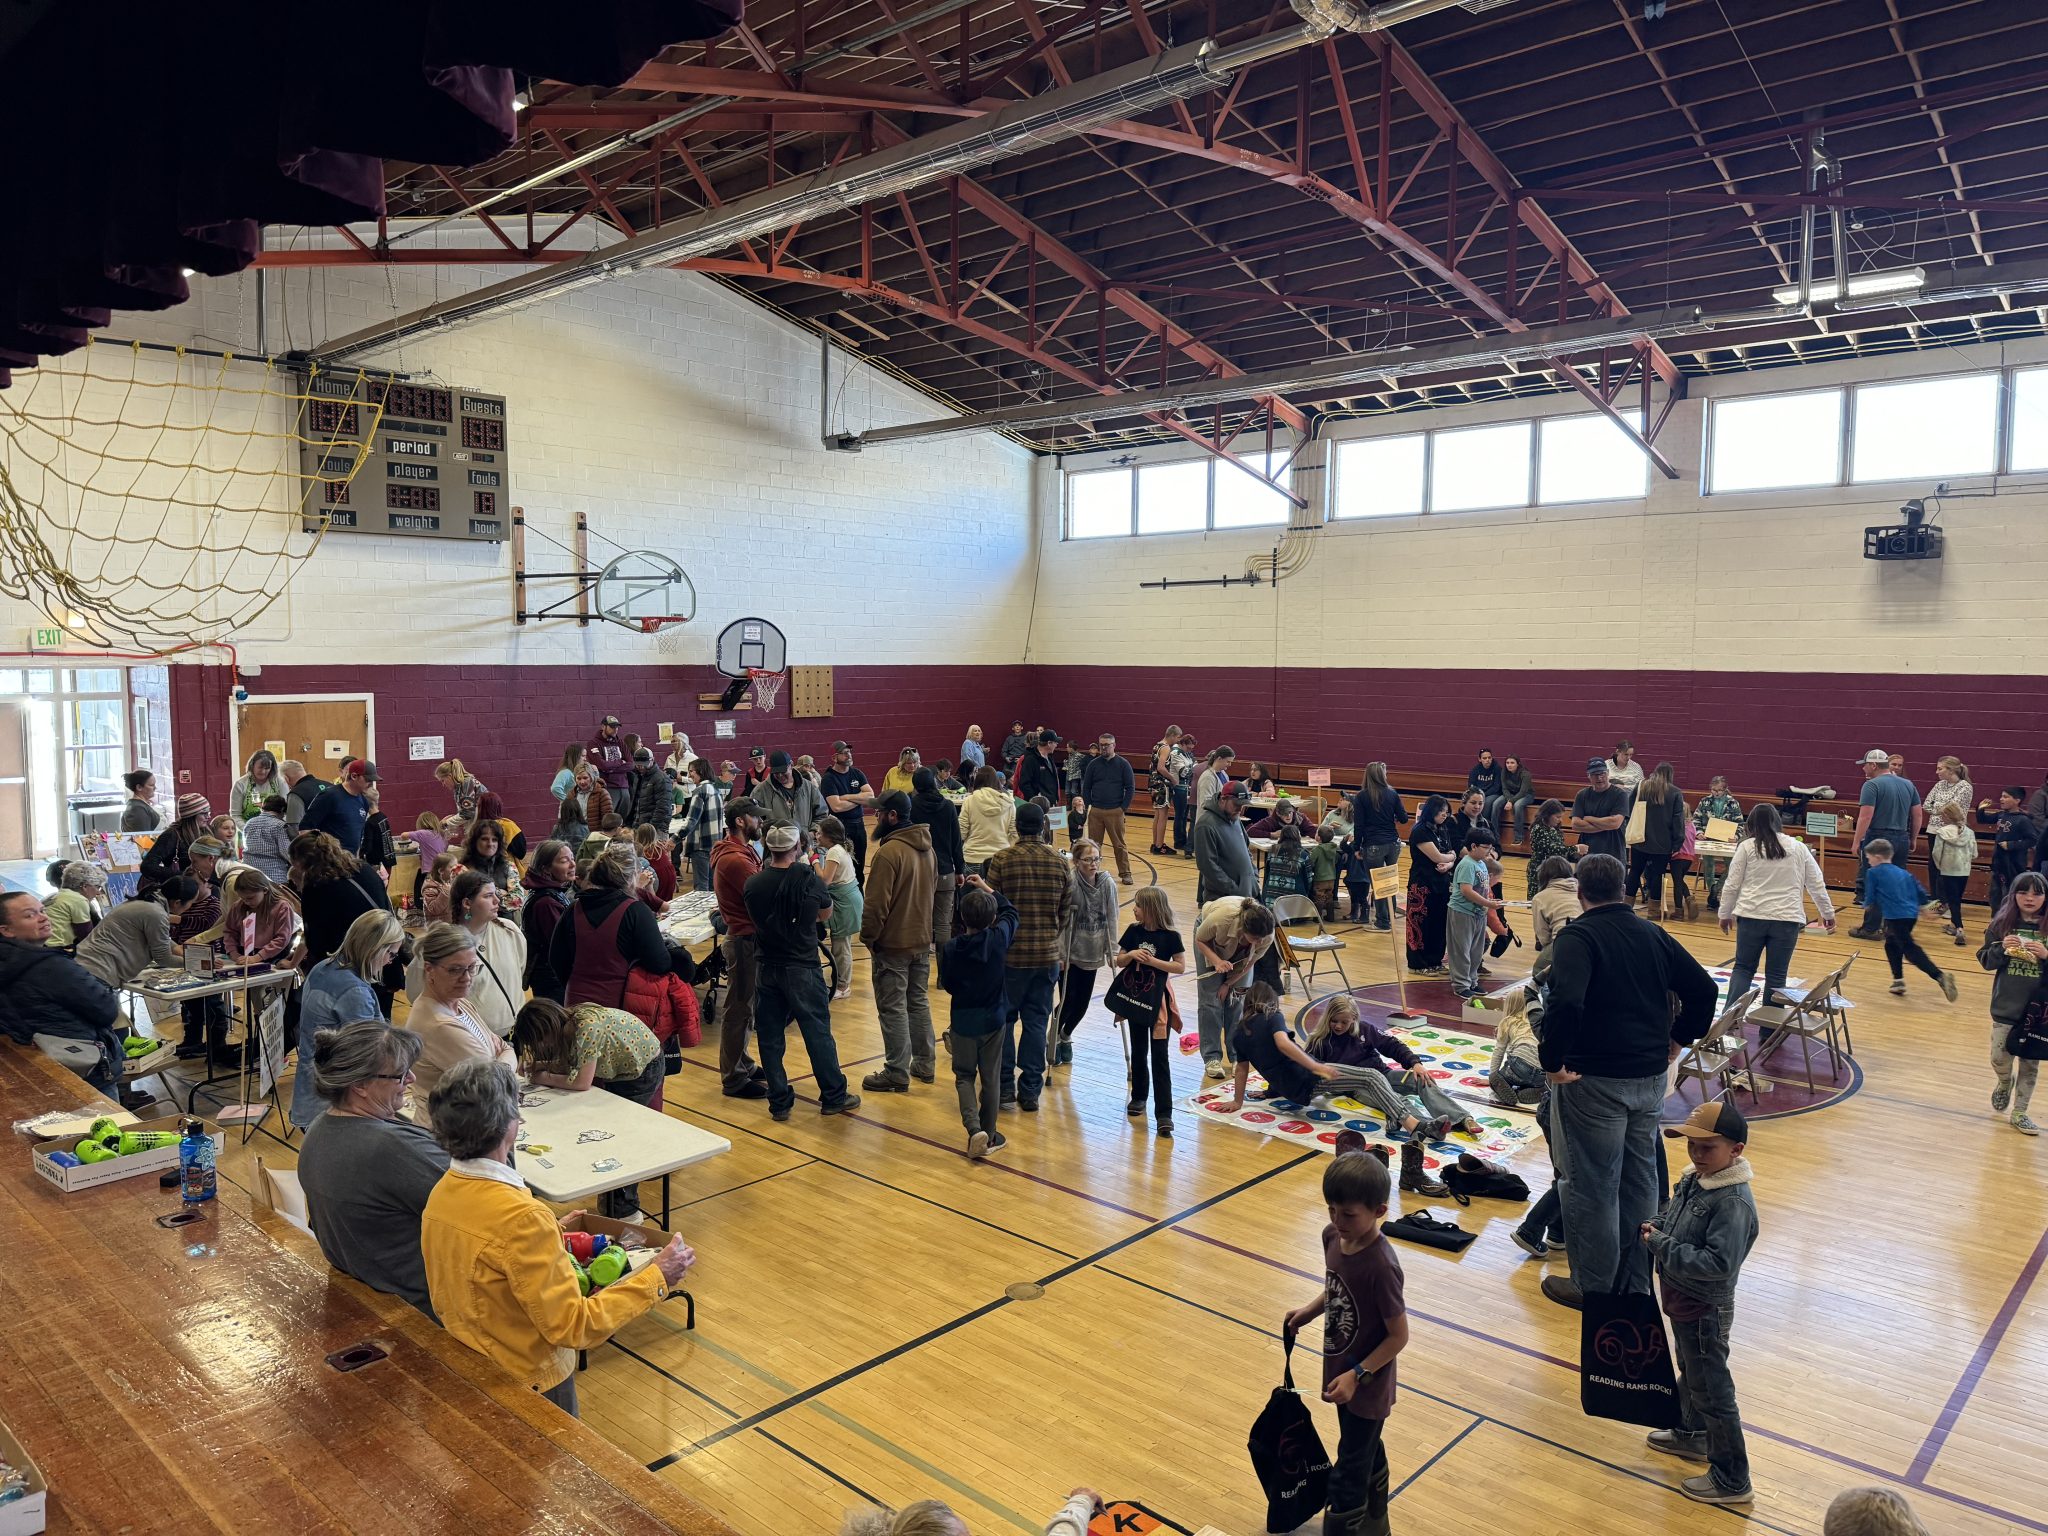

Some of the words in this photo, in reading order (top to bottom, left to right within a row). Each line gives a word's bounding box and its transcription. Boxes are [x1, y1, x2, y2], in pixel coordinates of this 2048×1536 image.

[315, 377, 351, 396] Home
[463, 397, 501, 416] Guests
[400, 422, 406, 431] 2
[418, 423, 423, 433] 3
[435, 426, 441, 435] 4
[392, 441, 431, 455] period
[394, 463, 431, 480] player
[471, 471, 497, 486] fouls
[395, 515, 434, 530] weight
[474, 520, 496, 535] bout
[37, 629, 62, 646] EXIT
[2008, 968, 2042, 977] WARS
[2009, 961, 2039, 970] STAR
[1589, 1374, 1625, 1389] READING
[1626, 1382, 1648, 1391] RAMS
[1649, 1383, 1673, 1396] ROCK!
[1114, 1513, 1143, 1532] K
